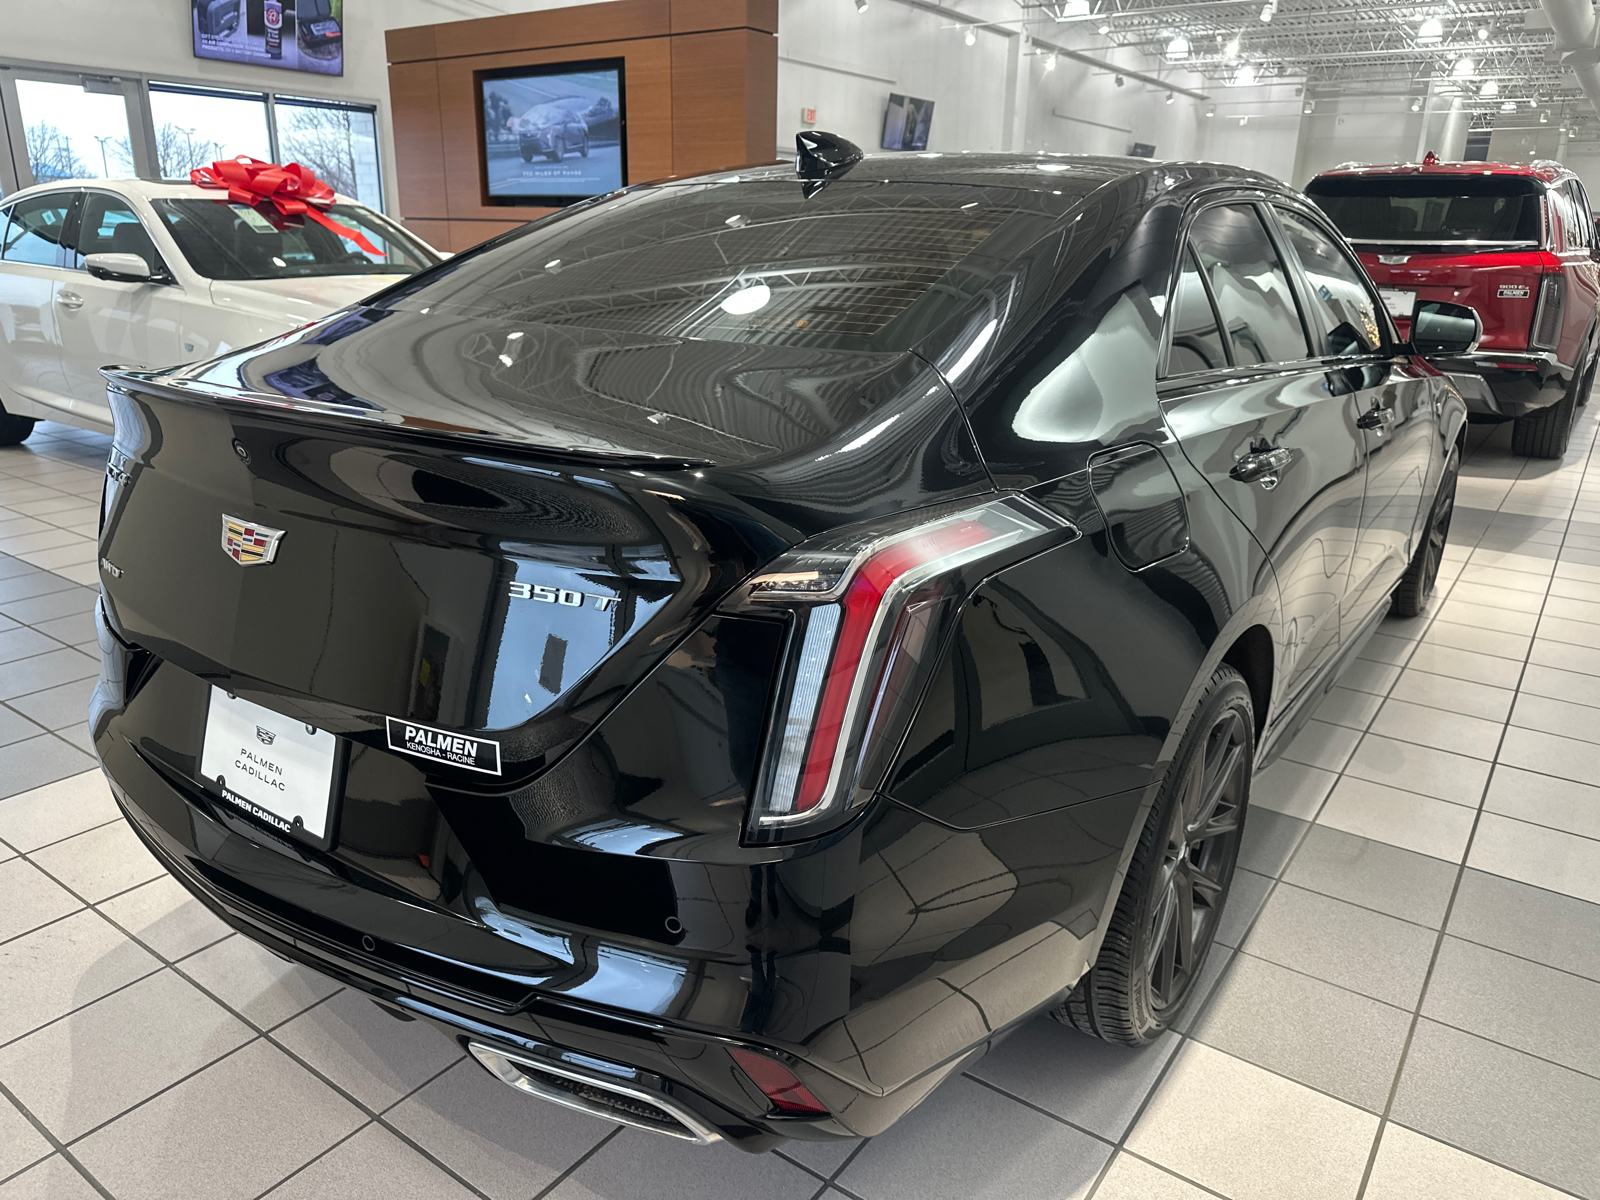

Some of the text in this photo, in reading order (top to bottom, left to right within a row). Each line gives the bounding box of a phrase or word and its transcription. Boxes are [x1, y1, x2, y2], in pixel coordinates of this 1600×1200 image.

[405, 726, 477, 757] PALMEN
[407, 741, 441, 757] KENOSHA
[447, 752, 475, 765] RACINE
[235, 760, 285, 791] CADILLAC
[240, 748, 283, 775] PALMEN
[222, 790, 251, 812] PALMEN
[252, 807, 290, 832] CADILLAC
